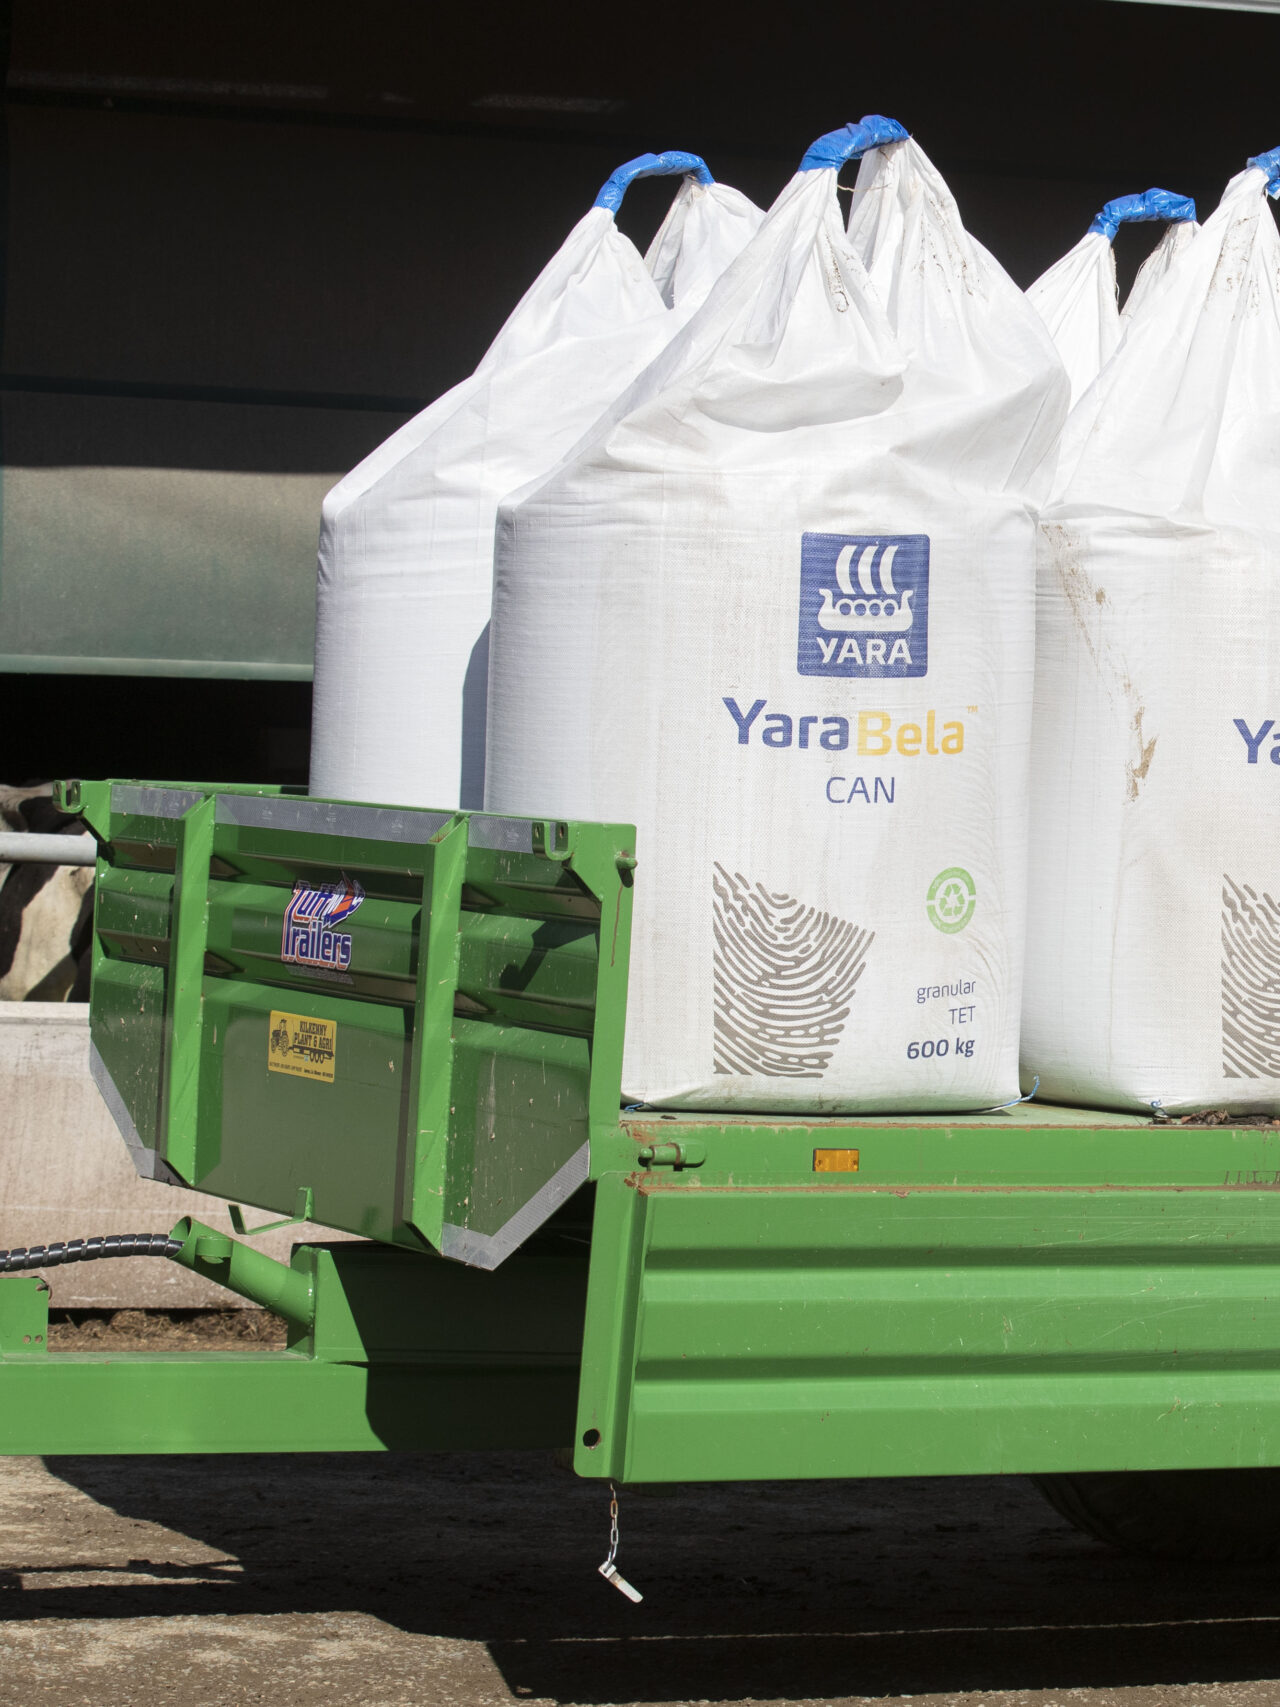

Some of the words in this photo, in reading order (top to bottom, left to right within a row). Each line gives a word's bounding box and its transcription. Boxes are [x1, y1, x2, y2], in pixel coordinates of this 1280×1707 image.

[815, 636, 913, 665] YARA
[825, 776, 895, 804] CAN
[917, 978, 977, 1003] granular
[948, 1005, 976, 1025] TET
[294, 1032, 313, 1047] PLANT
[906, 1038, 949, 1059] 600
[955, 1036, 975, 1058] kg
